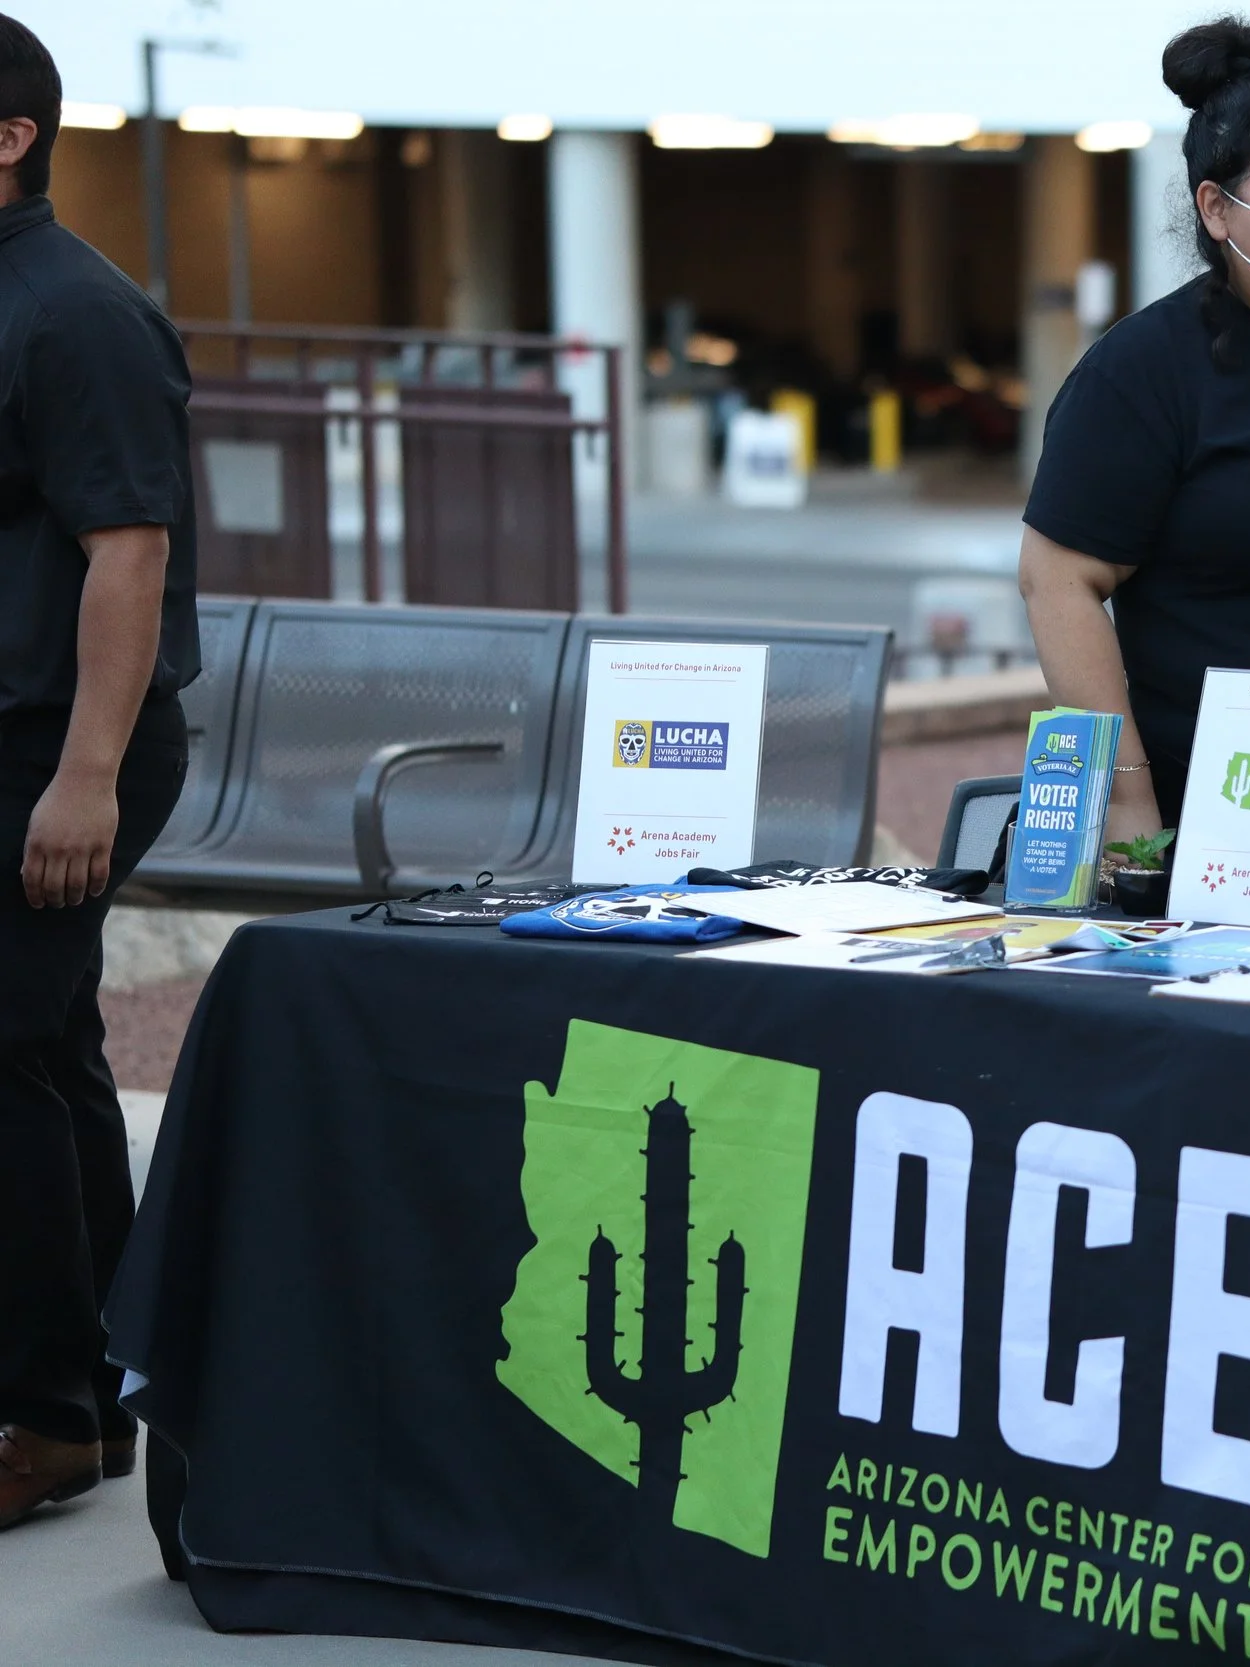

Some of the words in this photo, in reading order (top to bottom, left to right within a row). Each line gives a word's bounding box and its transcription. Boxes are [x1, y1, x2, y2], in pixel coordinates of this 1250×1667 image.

[610, 661, 633, 672] Living
[634, 662, 660, 671] United
[661, 663, 673, 671] for
[674, 663, 703, 673] Change
[704, 664, 711, 672] in
[712, 664, 742, 673] Arizona
[655, 727, 724, 745] LUCHA
[1059, 734, 1078, 749] ACE
[654, 748, 679, 756] LIVING
[681, 749, 707, 757] UNITED
[708, 749, 723, 757] FOR
[654, 755, 681, 763] CHANGE
[692, 756, 723, 764] ARIZONA
[1068, 765, 1077, 774] AZ
[1029, 783, 1079, 808] VOTER
[1024, 809, 1076, 831] RIGHTS
[640, 830, 670, 842] Arena
[671, 831, 717, 844] Academy
[1040, 841, 1067, 849] NOTHING
[655, 848, 679, 859] Jobs
[680, 848, 700, 859] Fair
[1055, 850, 1067, 858] THE
[826, 1452, 1011, 1529] ARIZONA
[1025, 1496, 1174, 1567] CENTER
